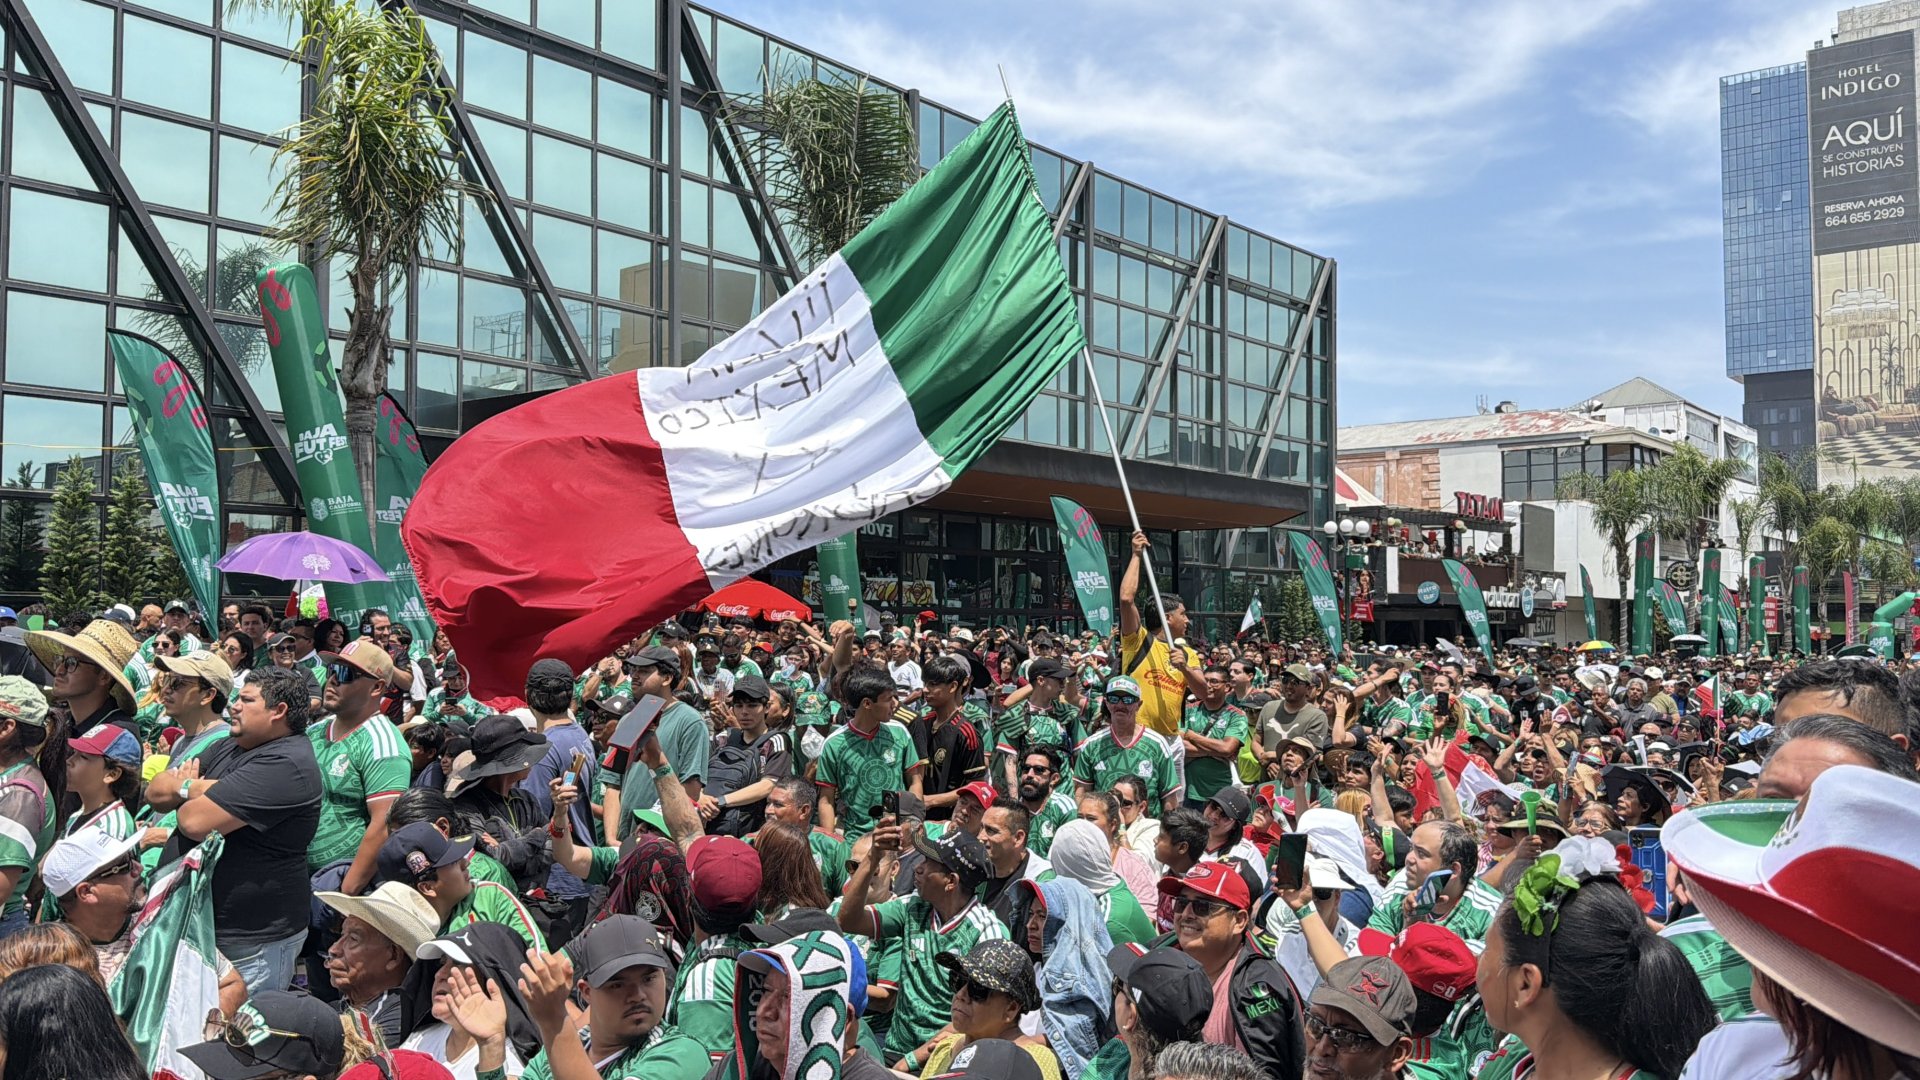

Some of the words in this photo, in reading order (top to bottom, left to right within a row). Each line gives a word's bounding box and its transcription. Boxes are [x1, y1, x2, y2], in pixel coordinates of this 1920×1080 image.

[1838, 63, 1882, 79] HOTEL
[1821, 73, 1900, 101] INDIGO
[1821, 106, 1904, 151] AQUÍ
[1822, 154, 1834, 163] SE
[1836, 143, 1904, 161] CONSTRUYEN
[1823, 154, 1905, 179] HISTORIAS
[1824, 200, 1866, 214] RESERVA
[1867, 194, 1905, 208] AHORA
[1825, 214, 1848, 227] 664
[1849, 210, 1872, 224] 655
[1873, 206, 1905, 221] 2929
[294, 437, 327, 459] FUT
[327, 495, 354, 506] BAJA
[1453, 491, 1505, 522] TATAMI
[716, 603, 750, 616] Coca-Cola
[1245, 997, 1279, 1019] MEXI
